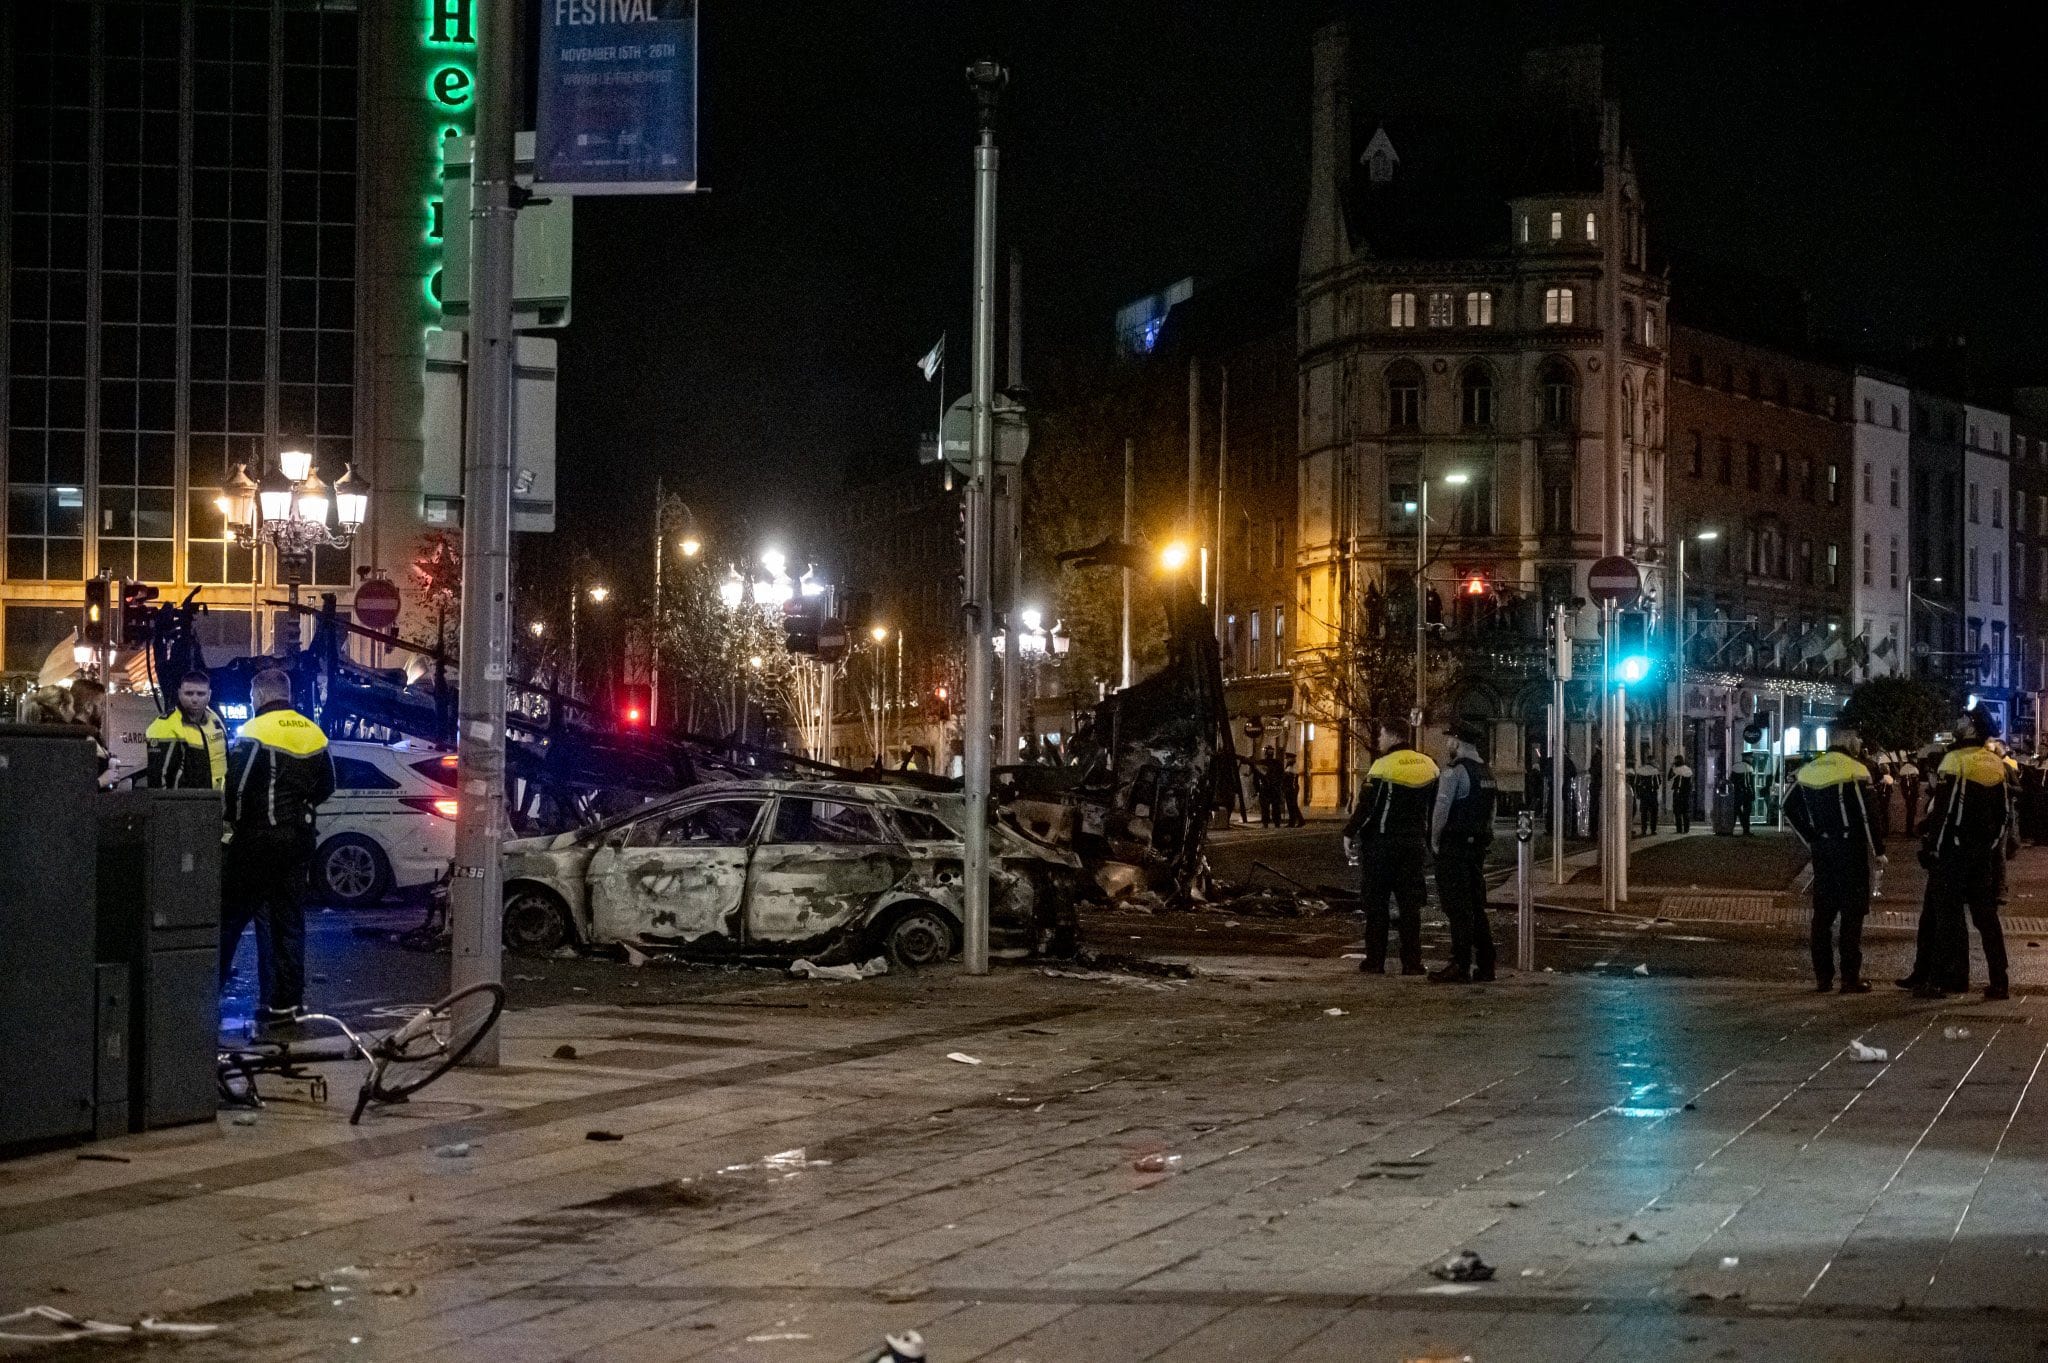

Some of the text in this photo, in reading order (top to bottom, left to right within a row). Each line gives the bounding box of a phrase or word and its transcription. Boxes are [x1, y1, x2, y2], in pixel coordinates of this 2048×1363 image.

[555, 0, 658, 26] FESTIVAL
[561, 46, 616, 61] NOVEMBER
[618, 45, 641, 60] 15TH
[278, 719, 311, 728] GARDA
[122, 732, 147, 743] GARDA
